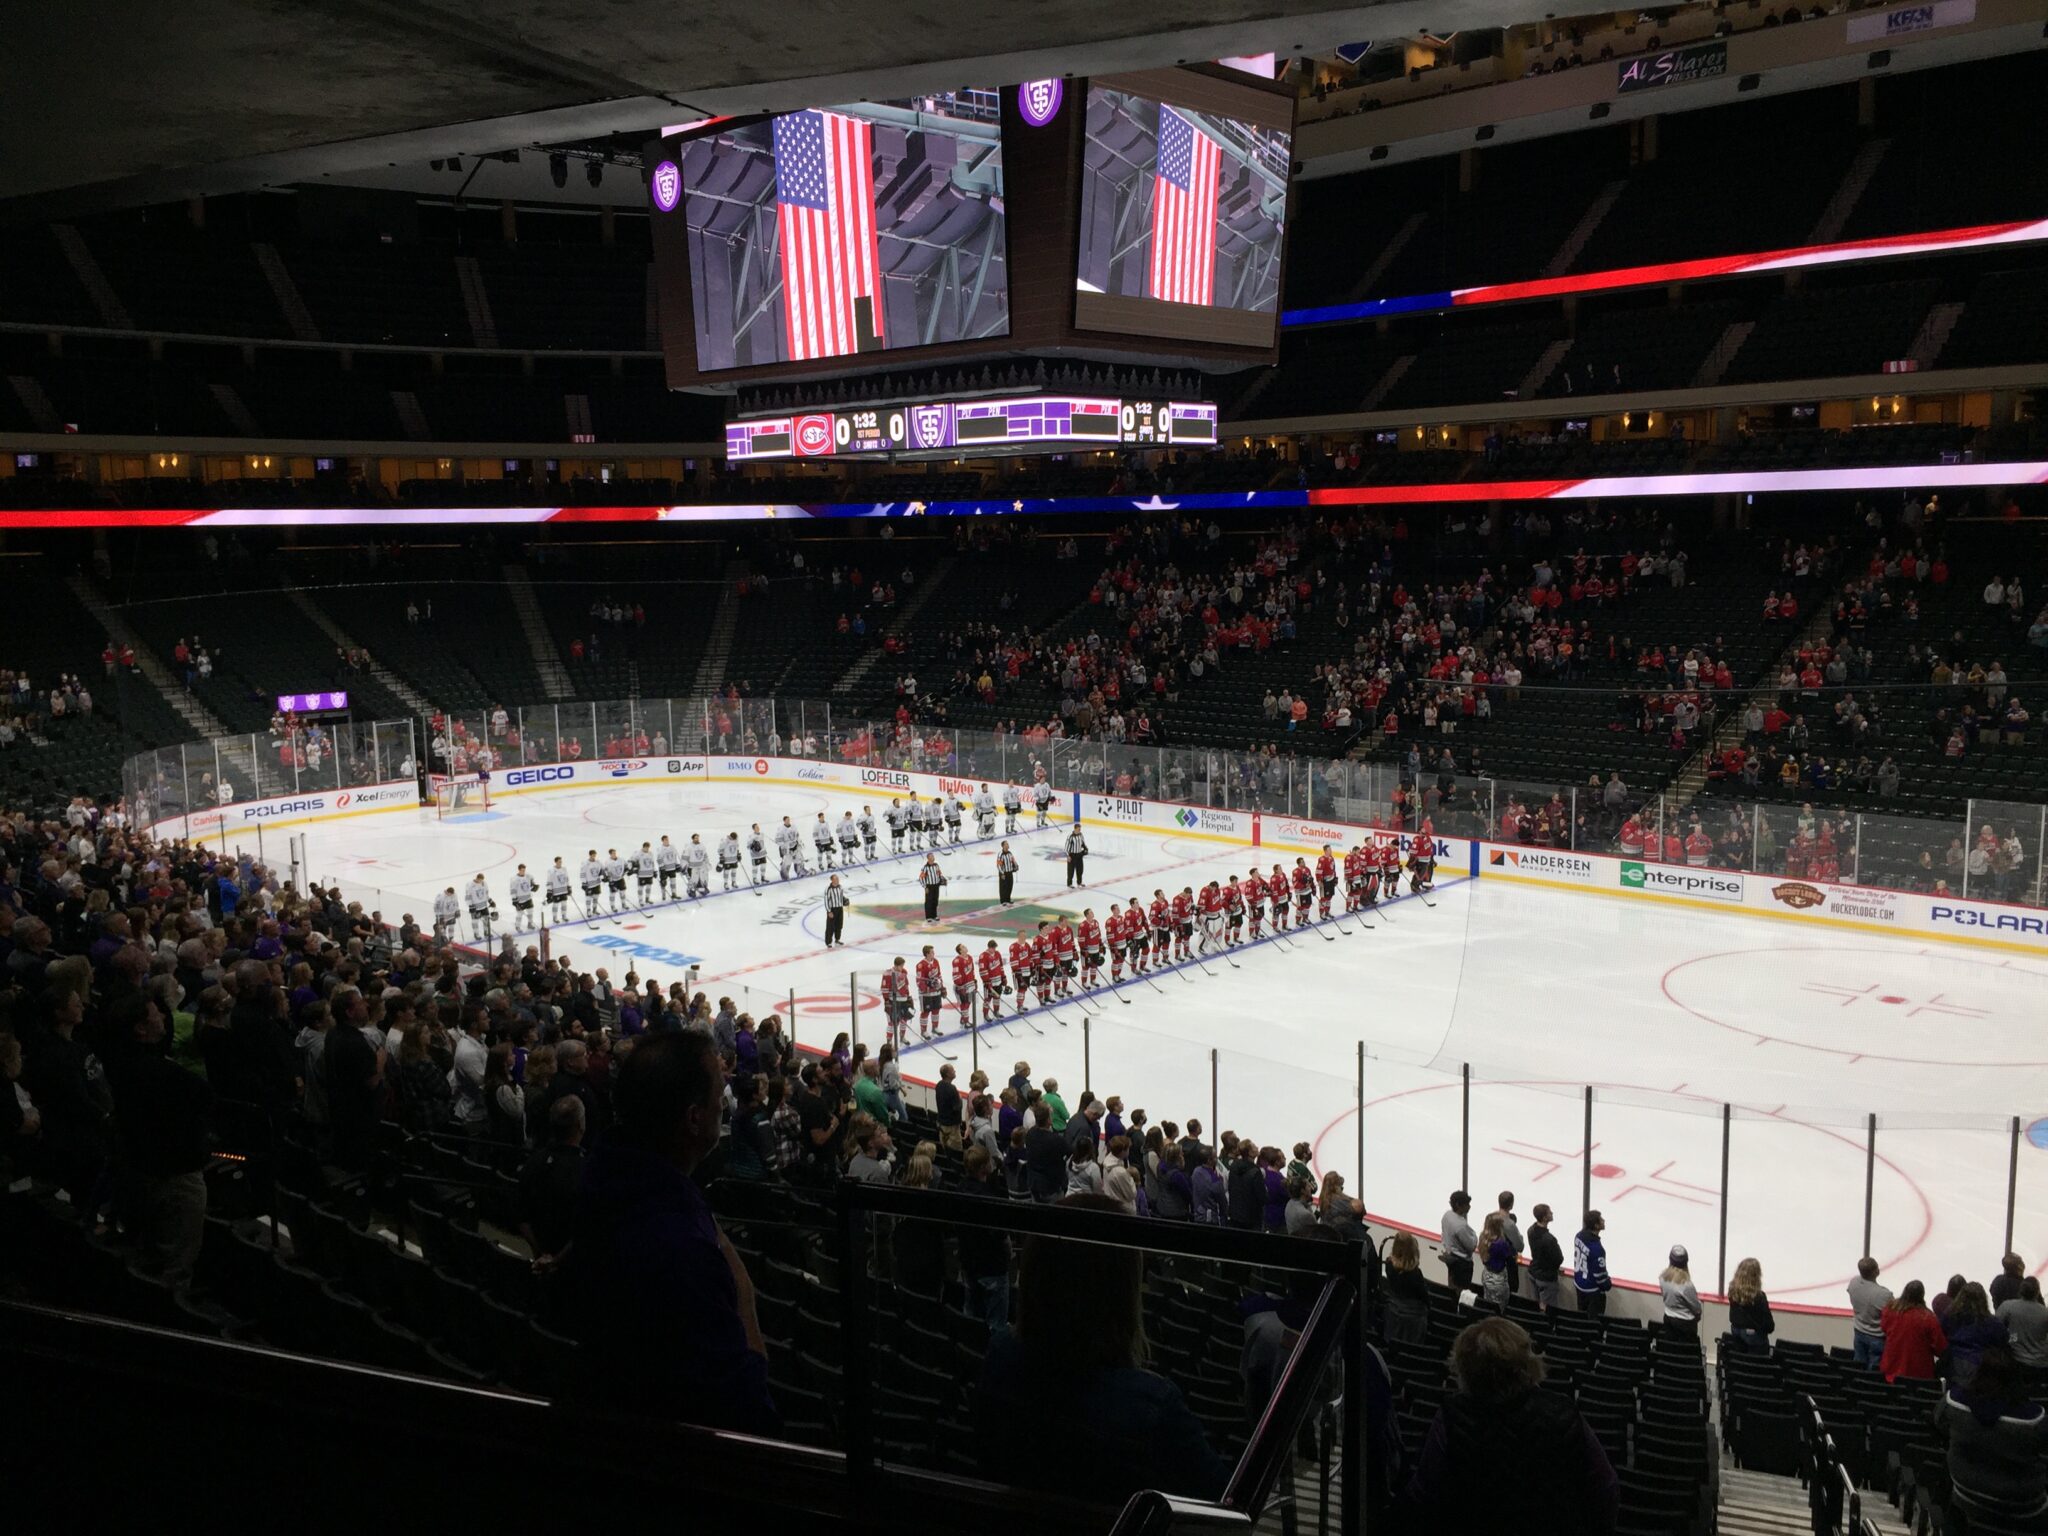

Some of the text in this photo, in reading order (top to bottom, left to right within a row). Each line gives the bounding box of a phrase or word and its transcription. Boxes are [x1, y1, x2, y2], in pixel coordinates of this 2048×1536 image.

[1619, 50, 1727, 88] Al Shaver
[1665, 64, 1727, 85] PRESS BOX
[1135, 402, 1152, 414] 1:32
[853, 412, 877, 428] 1:32
[1122, 405, 1169, 432] 0 0
[836, 418, 850, 445] 0
[889, 413, 904, 441] 0
[856, 441, 861, 449] 0
[881, 438, 886, 447] 0
[728, 762, 752, 771] BMO
[797, 767, 824, 781] Golden
[506, 766, 574, 786] GEICO
[861, 769, 910, 786] LOFFLER
[356, 788, 412, 803] Xcel Energy
[244, 798, 325, 820] POLARIS
[1117, 800, 1144, 816] PILOT
[1201, 810, 1232, 822] Regions
[1201, 822, 1235, 833] Hospital
[1300, 825, 1344, 840] Canidae
[1521, 853, 1591, 872] ANDERSEN
[1628, 867, 1741, 894] enterprise
[760, 906, 803, 927] Xcel
[1830, 902, 1895, 921] HOCKEYLODGE.COM
[1931, 906, 2048, 935] POLARI
